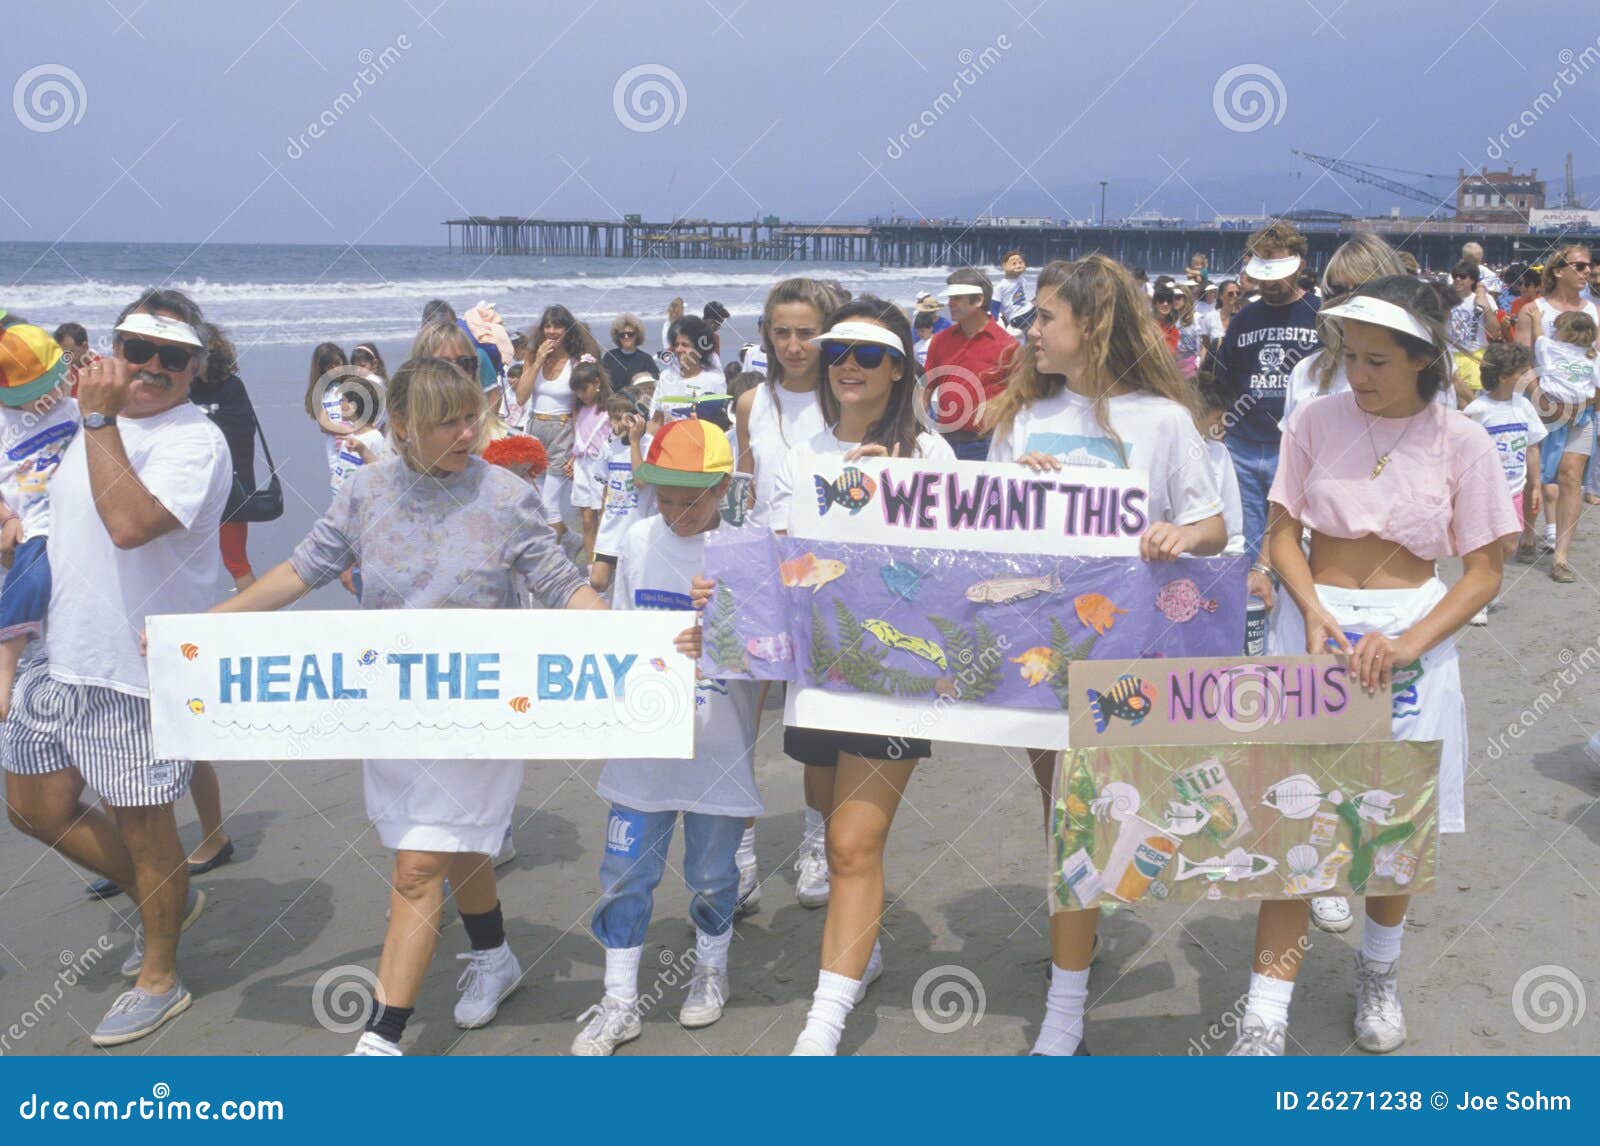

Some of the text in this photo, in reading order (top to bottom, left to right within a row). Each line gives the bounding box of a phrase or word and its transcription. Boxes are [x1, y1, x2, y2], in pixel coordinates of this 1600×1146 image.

[1237, 327, 1319, 347] UNIVERSITE
[1249, 374, 1290, 389] PARIS
[880, 468, 1149, 537] WE WANT THIS
[220, 652, 638, 703] HEAL THE BAY
[1168, 664, 1350, 724] NOT THIS
